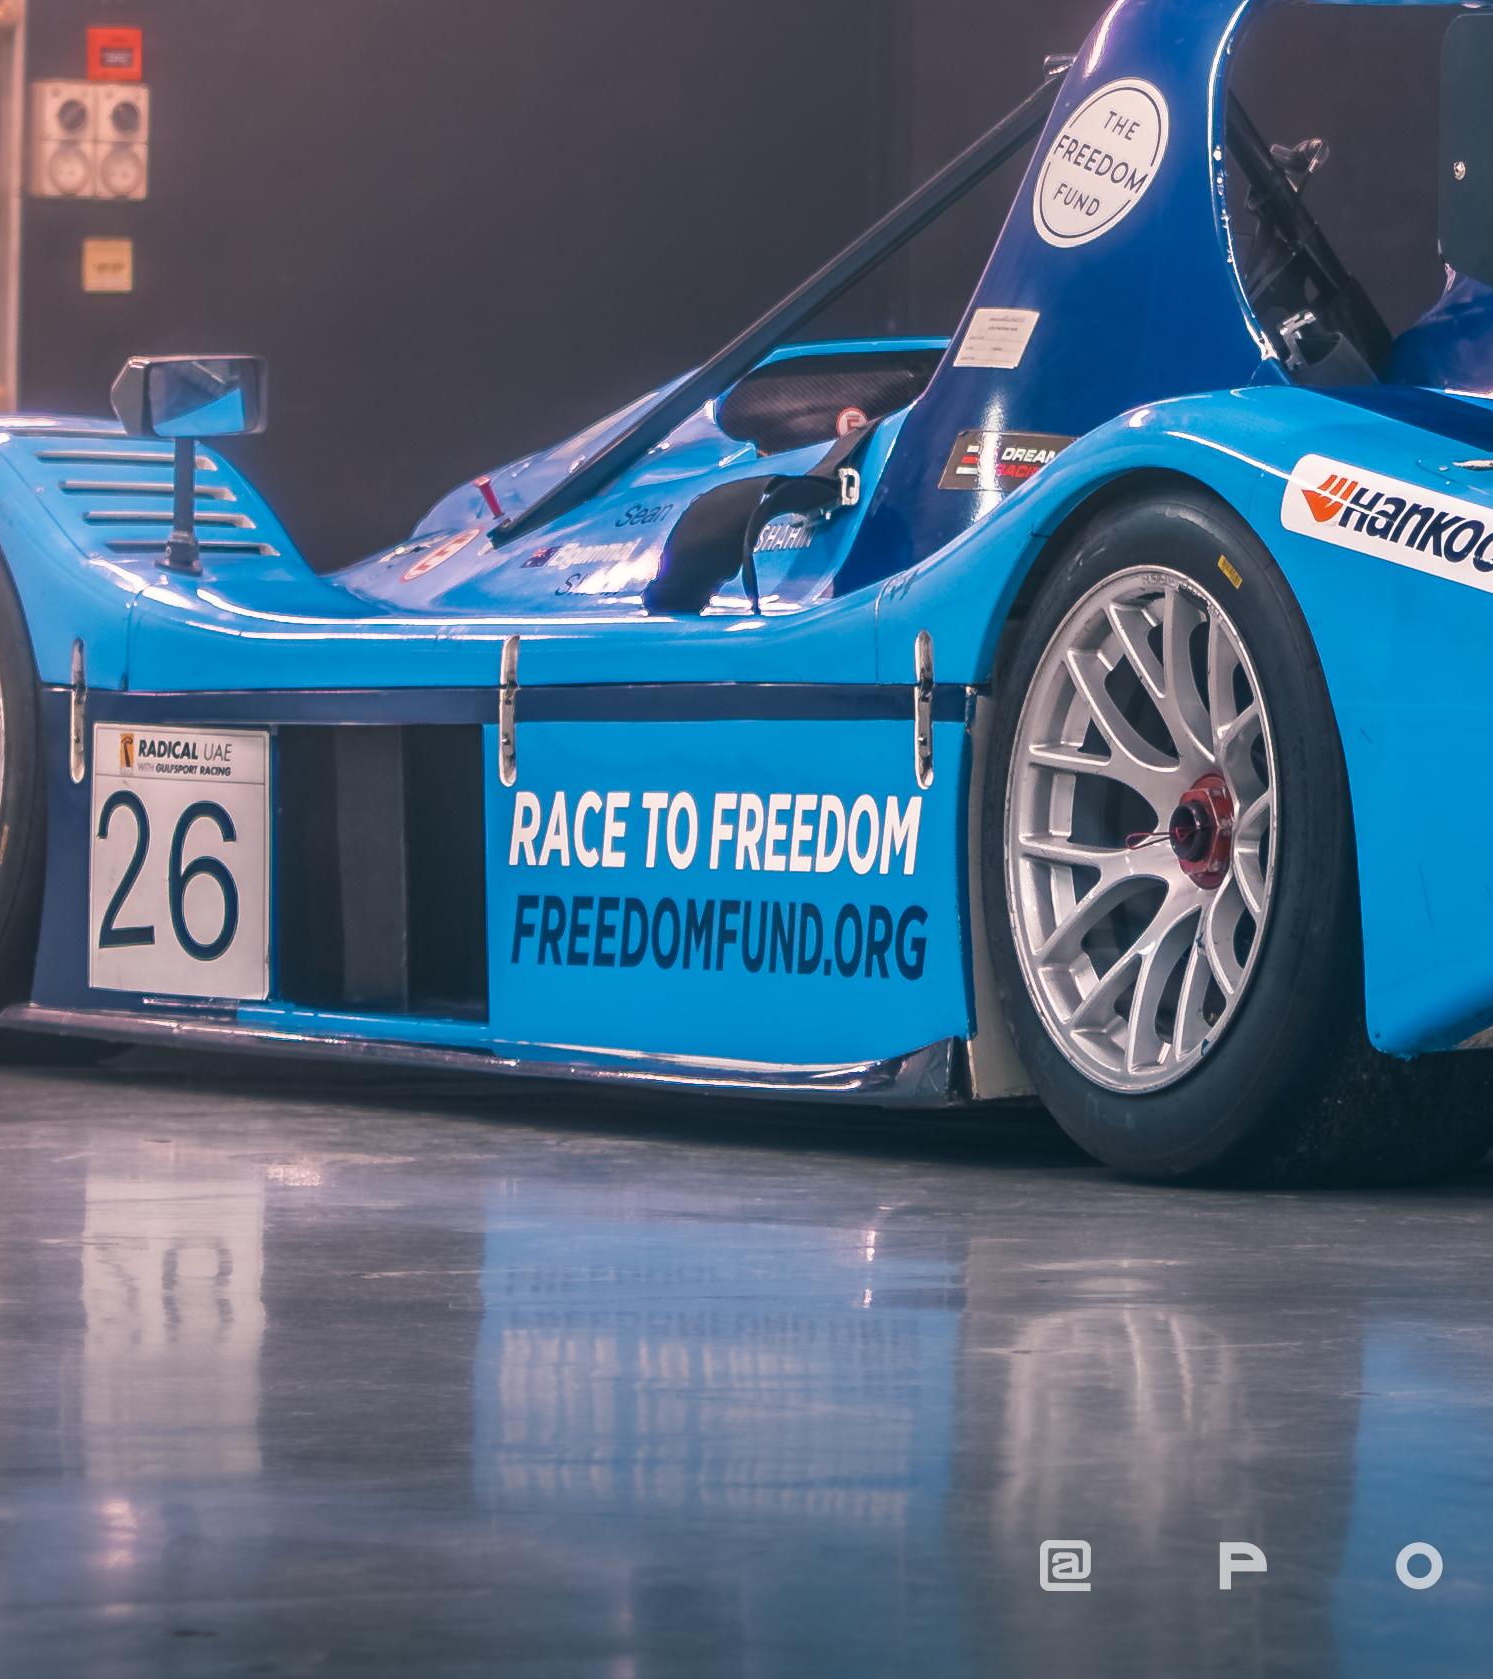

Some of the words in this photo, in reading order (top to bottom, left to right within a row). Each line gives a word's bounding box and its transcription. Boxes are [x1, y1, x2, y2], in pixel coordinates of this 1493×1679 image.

[1103, 110, 1141, 142] THE
[1053, 133, 1149, 195] FREEDOM
[1052, 182, 1101, 217] FUND
[615, 503, 674, 527] Sean
[138, 738, 199, 760] RADICAL
[203, 742, 233, 762] UAE
[156, 763, 199, 775] GULFSPORT
[199, 765, 232, 777] RACING
[508, 790, 631, 869] RACE
[641, 791, 699, 870] TO
[709, 792, 923, 876] FREEDOM
[97, 789, 239, 962] 26
[510, 894, 929, 981] FREEDOMFUND.ORG
